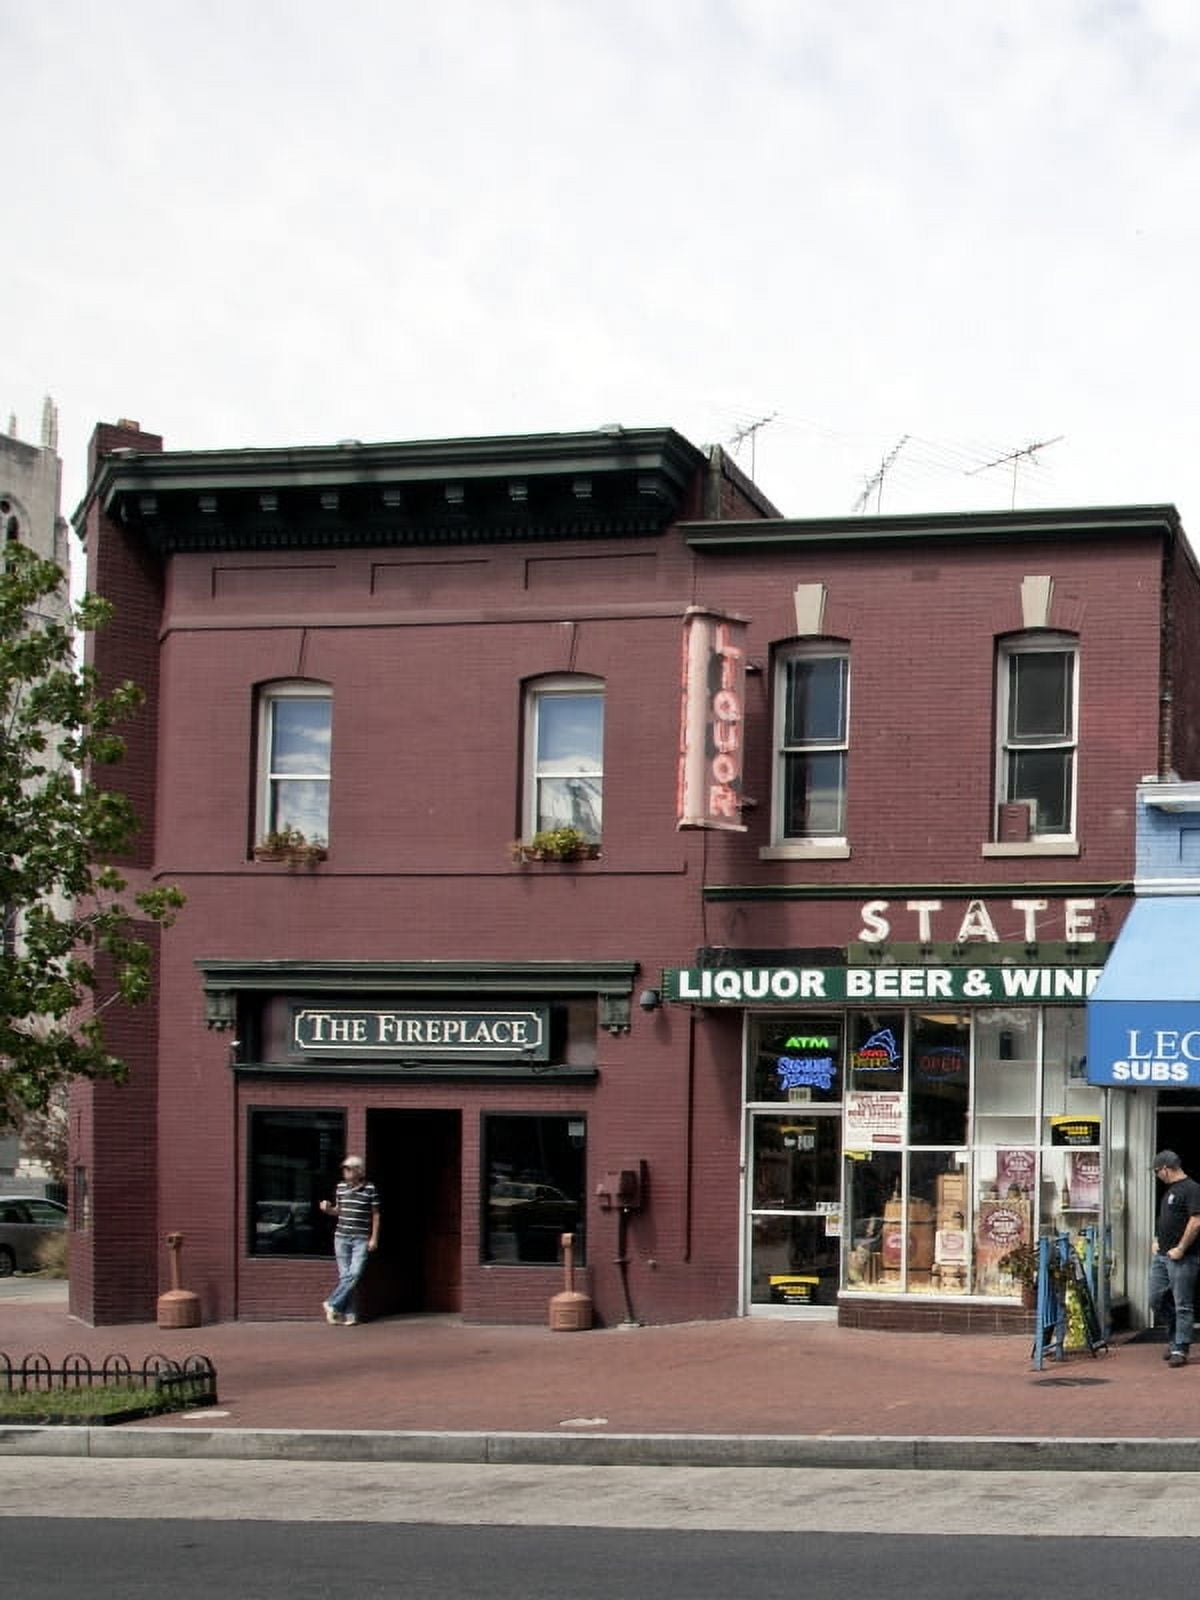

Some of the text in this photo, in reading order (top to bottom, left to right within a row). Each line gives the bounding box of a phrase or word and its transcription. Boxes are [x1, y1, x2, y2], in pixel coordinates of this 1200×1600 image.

[711, 622, 742, 817] LIQUOR
[858, 899, 1097, 942] STATE
[679, 970, 826, 1000] LIQUOR
[846, 969, 953, 997] BEER
[963, 969, 993, 996] &
[308, 1013, 529, 1044] THE FIREPLACE
[785, 1036, 829, 1048] ATM
[920, 1055, 961, 1071] OPEN
[1112, 1060, 1189, 1082] SUBS
